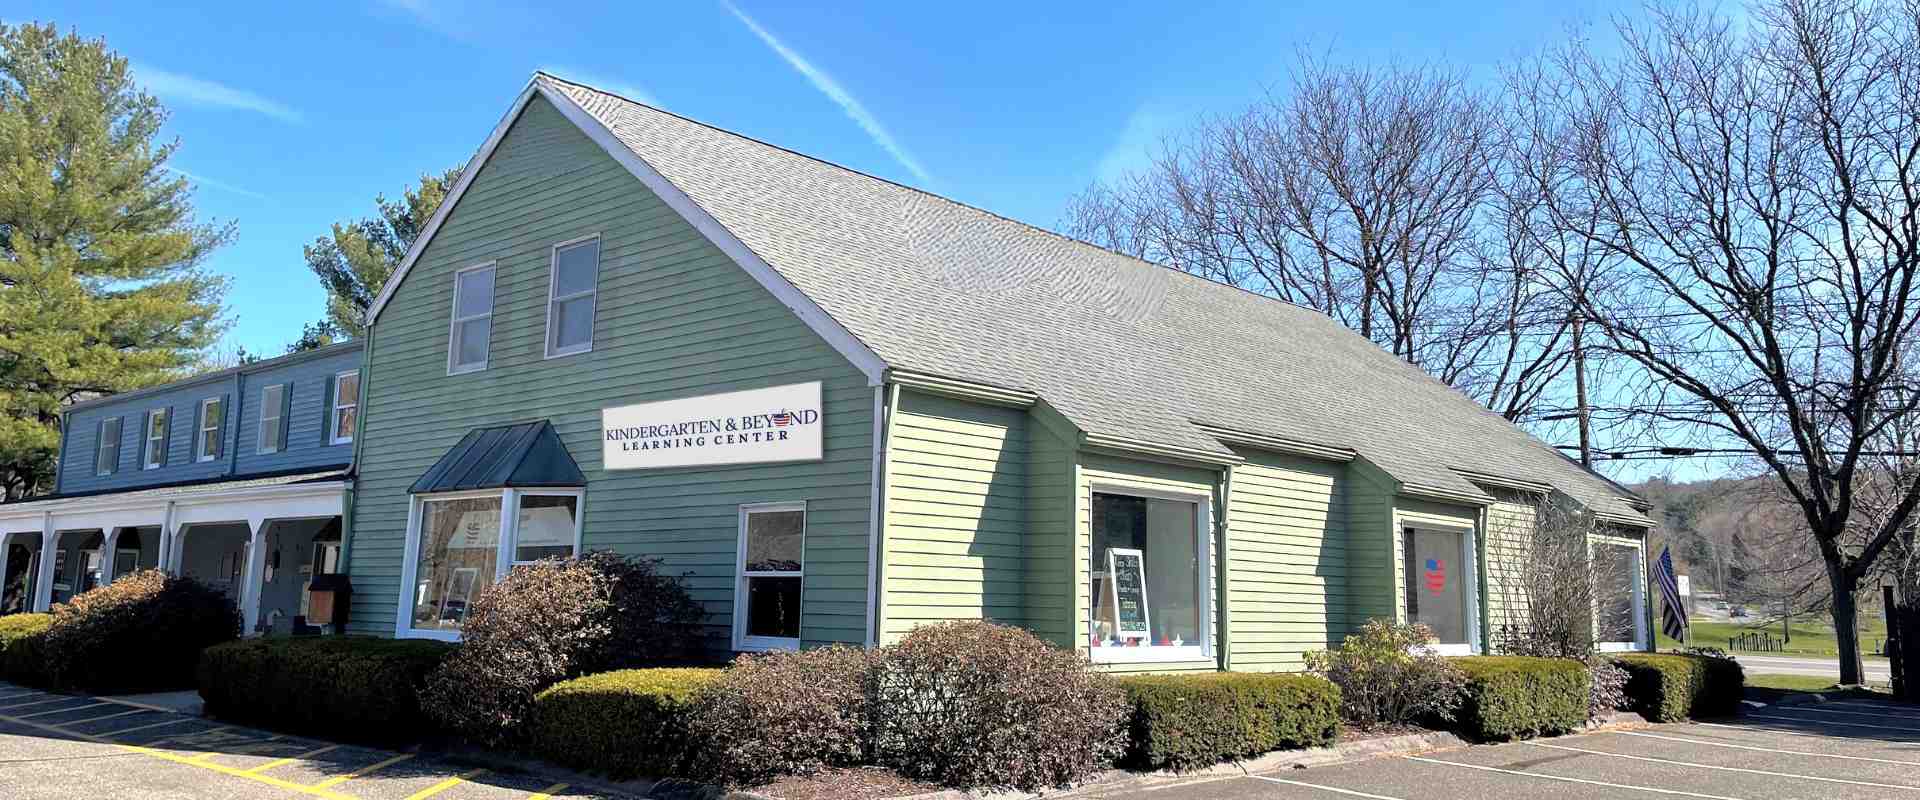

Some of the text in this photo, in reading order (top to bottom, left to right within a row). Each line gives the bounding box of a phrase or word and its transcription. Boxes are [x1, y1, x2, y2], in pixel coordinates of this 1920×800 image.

[606, 419, 721, 441] KINDERGARTEN
[725, 418, 737, 431] &
[623, 430, 789, 451] LEARNING CENTER
